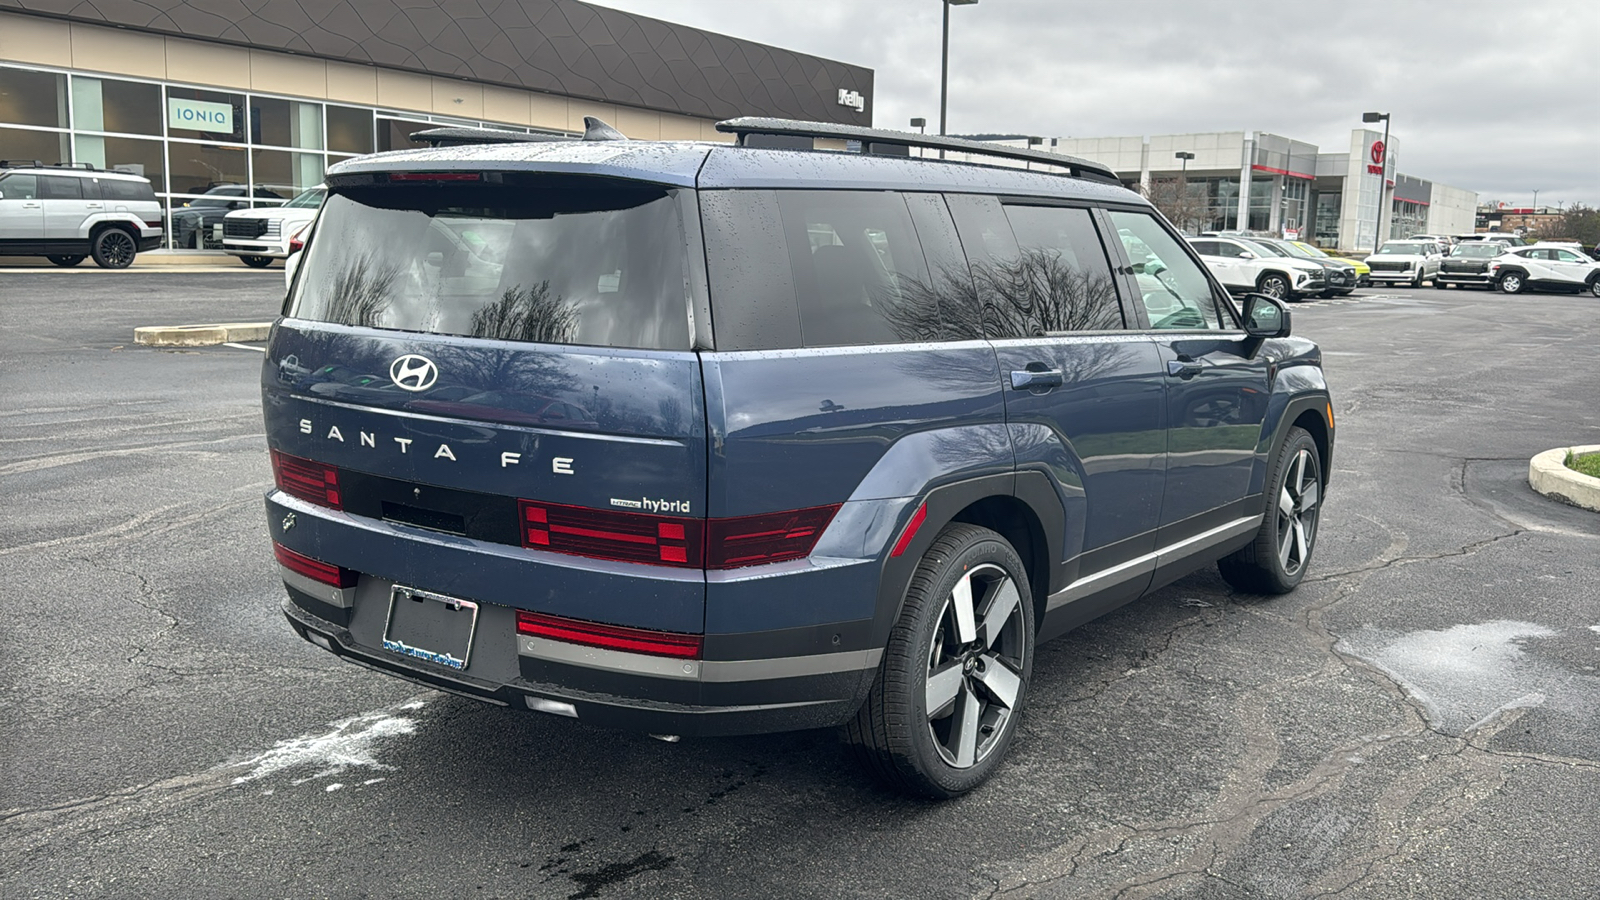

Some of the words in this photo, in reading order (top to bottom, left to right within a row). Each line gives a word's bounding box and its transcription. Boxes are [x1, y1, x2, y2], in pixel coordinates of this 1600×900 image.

[838, 89, 864, 112] Kelly
[177, 108, 225, 124] IONIQ
[299, 418, 457, 462] SANTA
[501, 451, 575, 475] FE
[643, 497, 690, 513] hybrid
